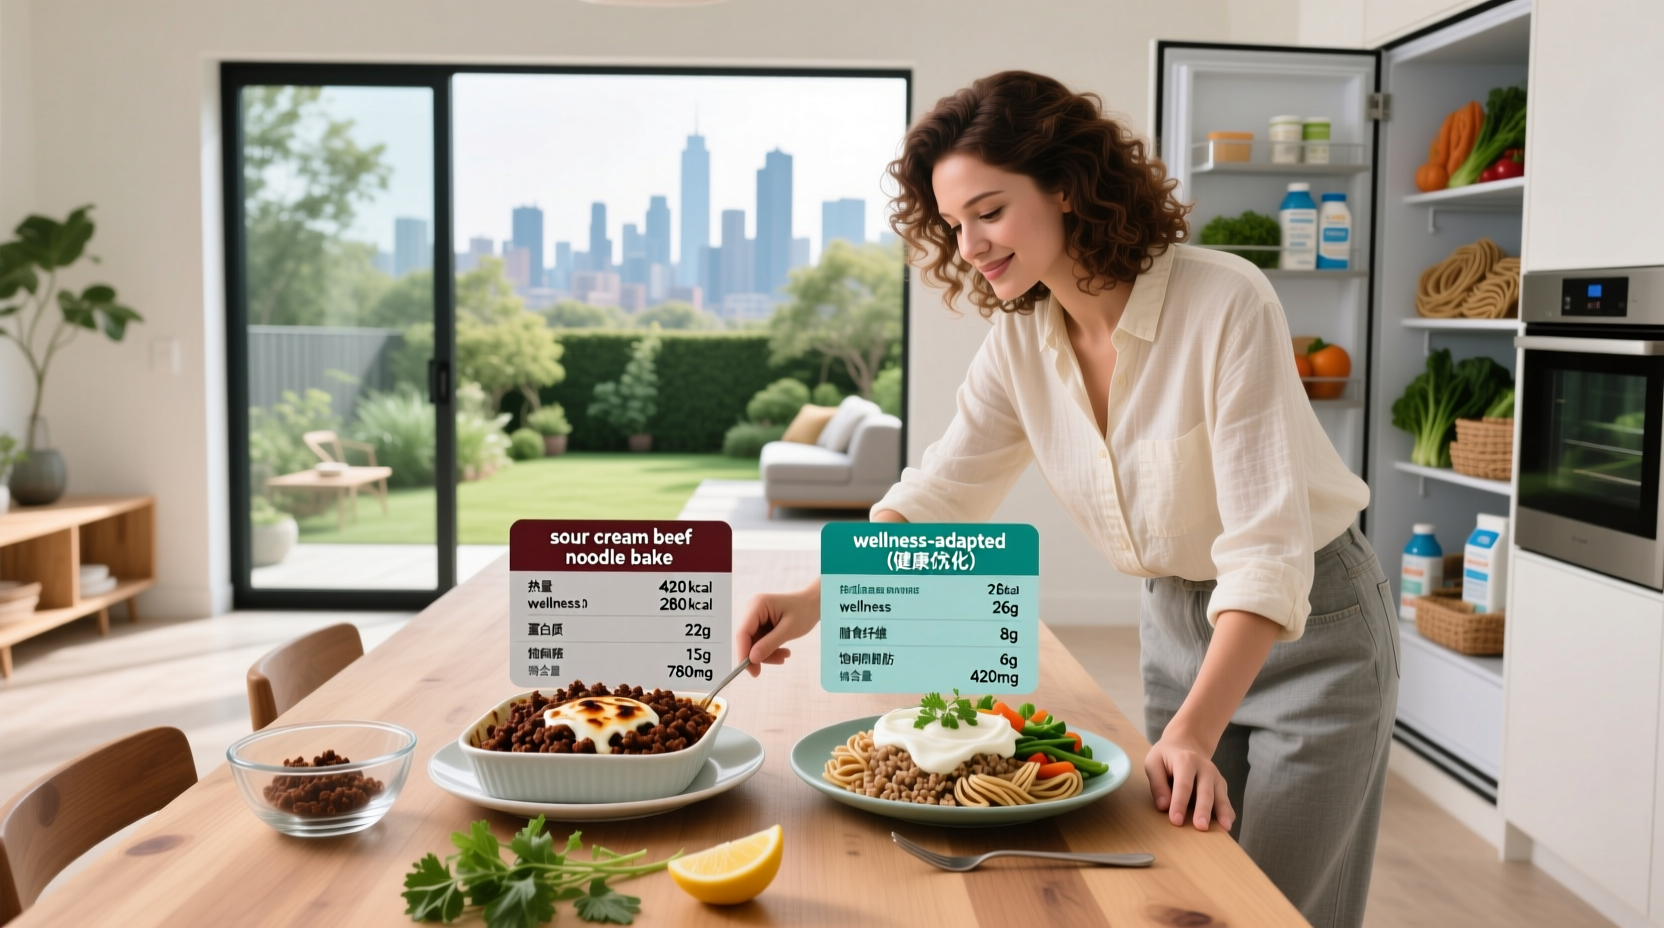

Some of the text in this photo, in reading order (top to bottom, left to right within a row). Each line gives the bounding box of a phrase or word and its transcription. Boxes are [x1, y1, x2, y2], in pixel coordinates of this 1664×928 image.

[550, 528, 693, 545] sour cream beef
[853, 531, 1006, 551] wellness-adapted
[565, 549, 673, 566] noodle bake
[659, 580, 712, 593] 420 kcal
[840, 600, 891, 612] wellness
[992, 600, 1019, 617] 26g
[685, 623, 711, 639] 22g
[1000, 627, 1018, 643] 8g
[686, 648, 711, 664] 15g
[1000, 653, 1018, 669] 6g
[667, 665, 713, 681] 780mg
[970, 669, 1019, 687] 420mg
